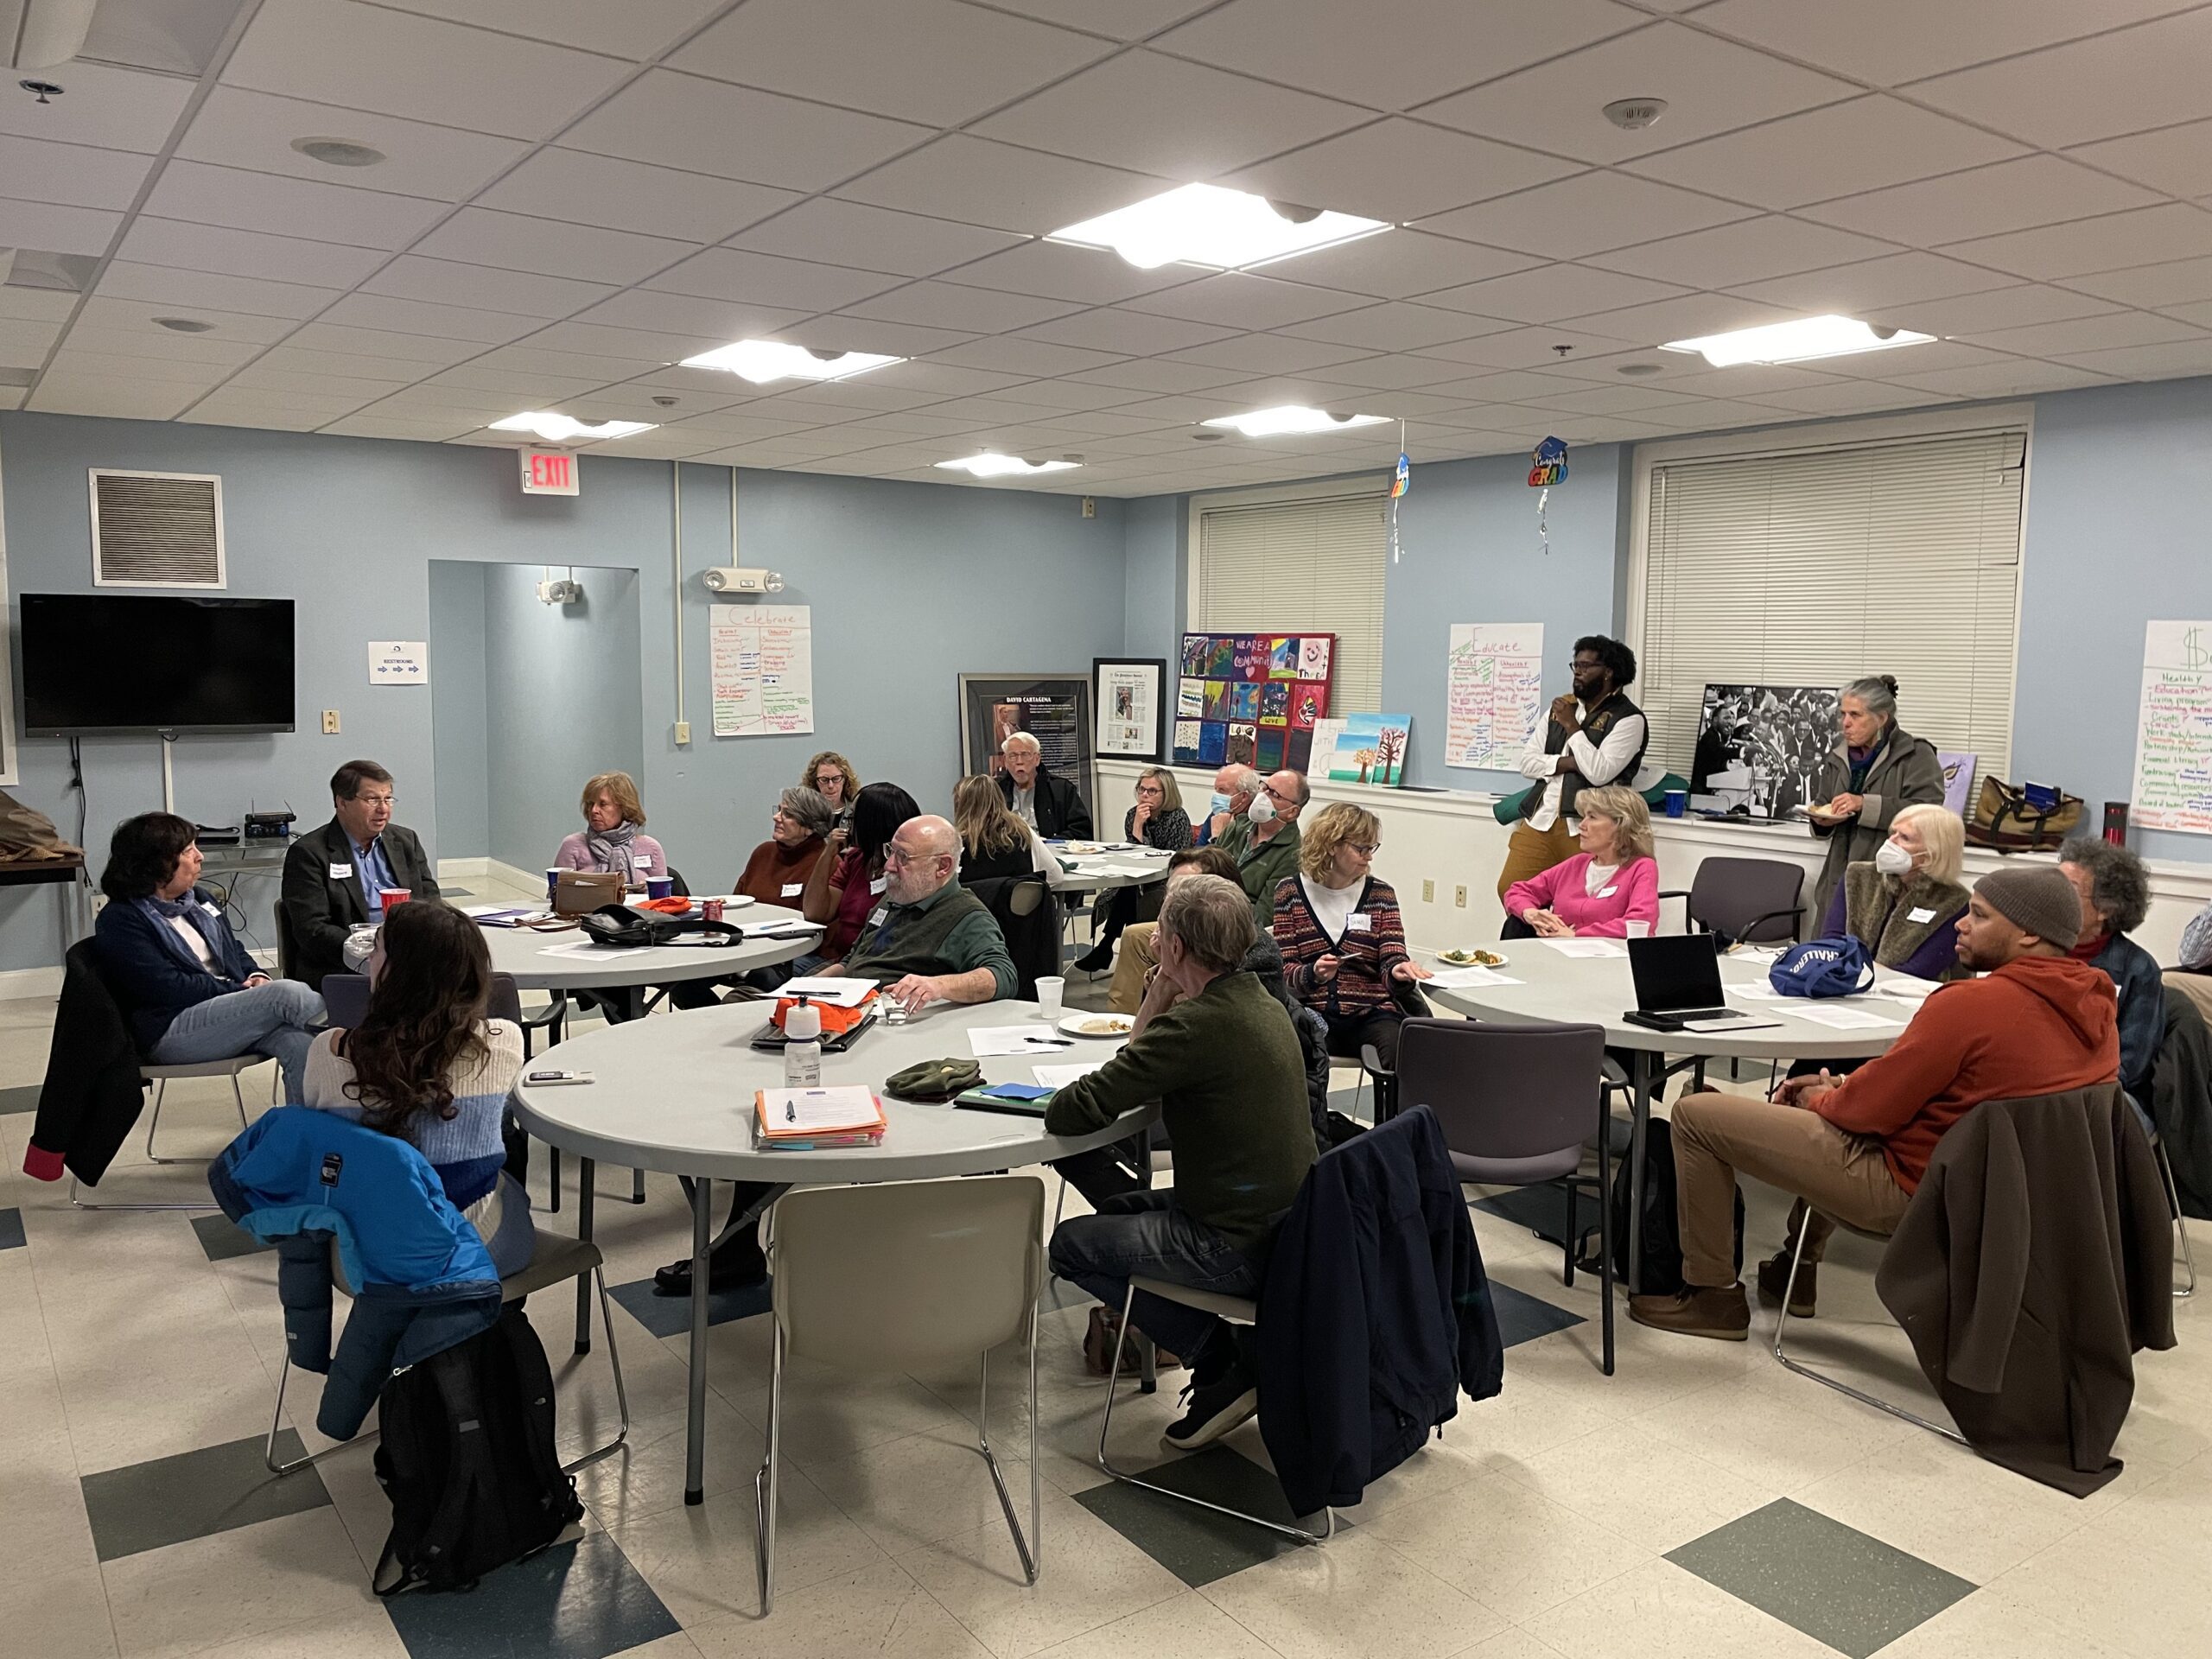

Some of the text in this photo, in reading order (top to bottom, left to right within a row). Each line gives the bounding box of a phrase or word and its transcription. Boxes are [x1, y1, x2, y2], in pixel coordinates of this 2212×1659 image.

[530, 454, 570, 487] EXIT
[1528, 467, 1568, 486] GRAD
[1472, 626, 1522, 652] Educate
[2163, 673, 2202, 684] Healthy
[2155, 684, 2198, 695] Education
[2149, 692, 2173, 706] Living
